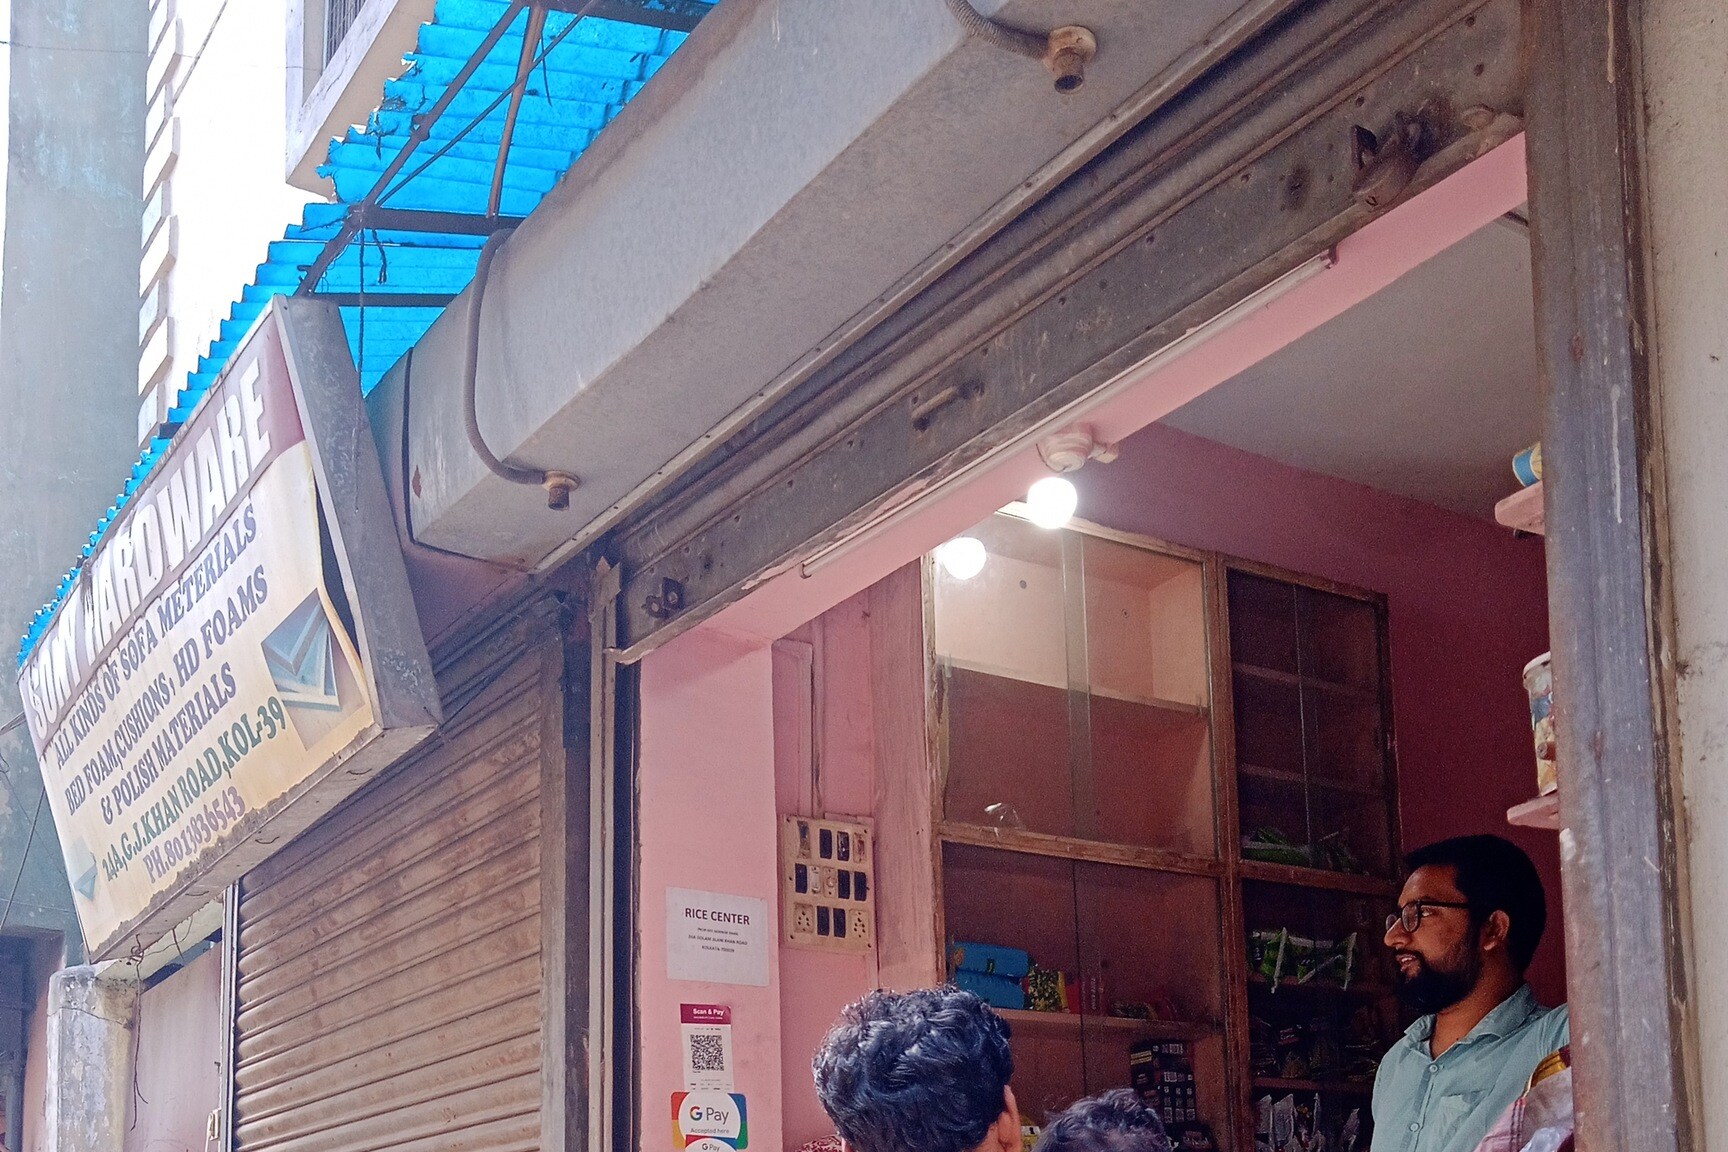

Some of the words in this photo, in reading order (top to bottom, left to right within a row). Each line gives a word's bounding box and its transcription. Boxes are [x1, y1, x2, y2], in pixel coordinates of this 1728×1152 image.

[27, 586, 84, 740] SONY
[80, 357, 272, 664] HARDWARE
[57, 727, 75, 770] ALL
[68, 684, 107, 747] KINDS
[102, 660, 121, 701] OF
[119, 619, 159, 681] SOFA
[156, 502, 257, 639] METERIALS
[64, 773, 87, 817] BED
[172, 637, 201, 688] HD
[200, 564, 268, 660] FOAMS
[101, 795, 114, 826] &
[111, 748, 160, 816] POLISH
[152, 661, 237, 772] MATERIALS
[685, 907, 708, 920] RICE
[710, 911, 750, 925] CENTER
[713, 1008, 725, 1016] Pay
[689, 1106, 703, 1121] G
[706, 1107, 729, 1124] Pay
[690, 1127, 717, 1135] Accepted
[709, 1143, 720, 1152] Pay
